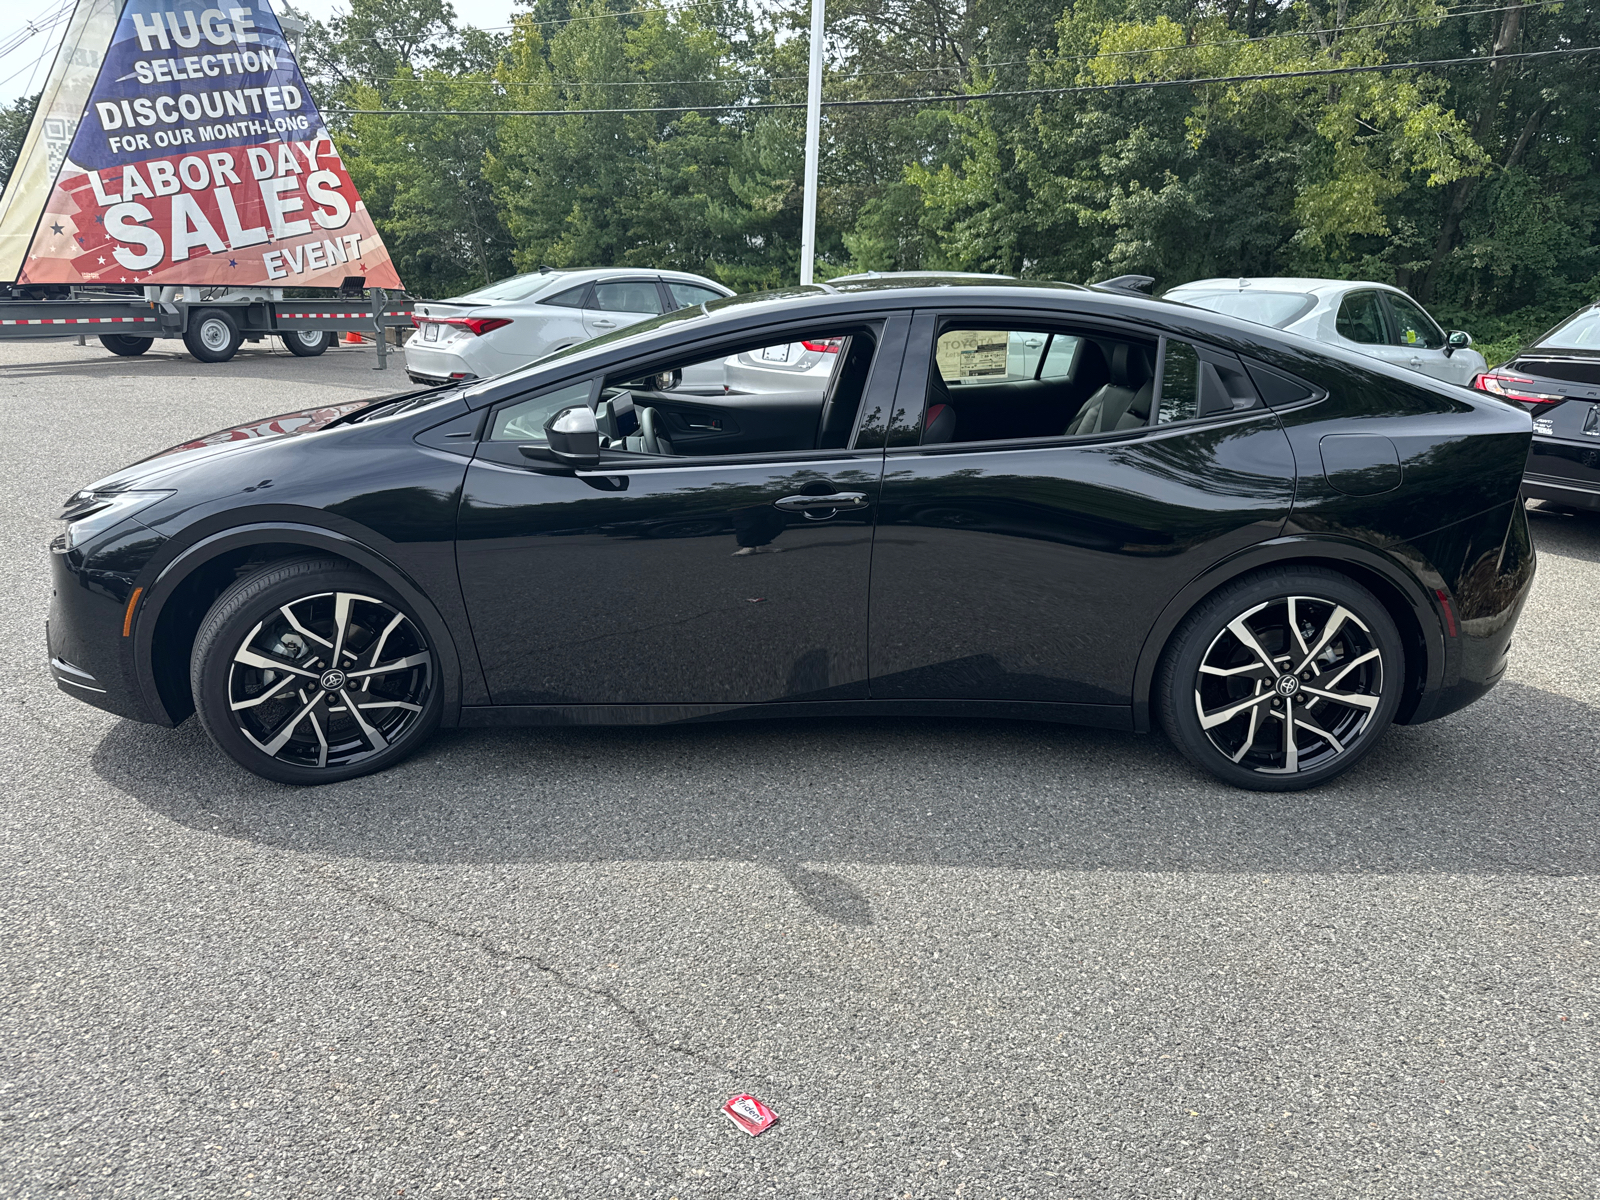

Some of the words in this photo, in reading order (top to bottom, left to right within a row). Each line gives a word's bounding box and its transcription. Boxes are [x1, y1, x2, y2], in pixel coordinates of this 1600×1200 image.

[132, 7, 260, 51] HUGE
[134, 50, 278, 85] SELECTION
[95, 85, 302, 131] DISCOUNTED
[108, 133, 150, 154] FOR
[155, 128, 196, 148] OUR
[199, 115, 309, 141] MONTH-LONG
[88, 152, 241, 207] LABOR
[247, 140, 320, 181] DAY
[103, 171, 352, 272] SALES
[262, 233, 363, 280] EVENT
[943, 338, 993, 350] TOYOTA
[737, 1098, 764, 1121] Trident
